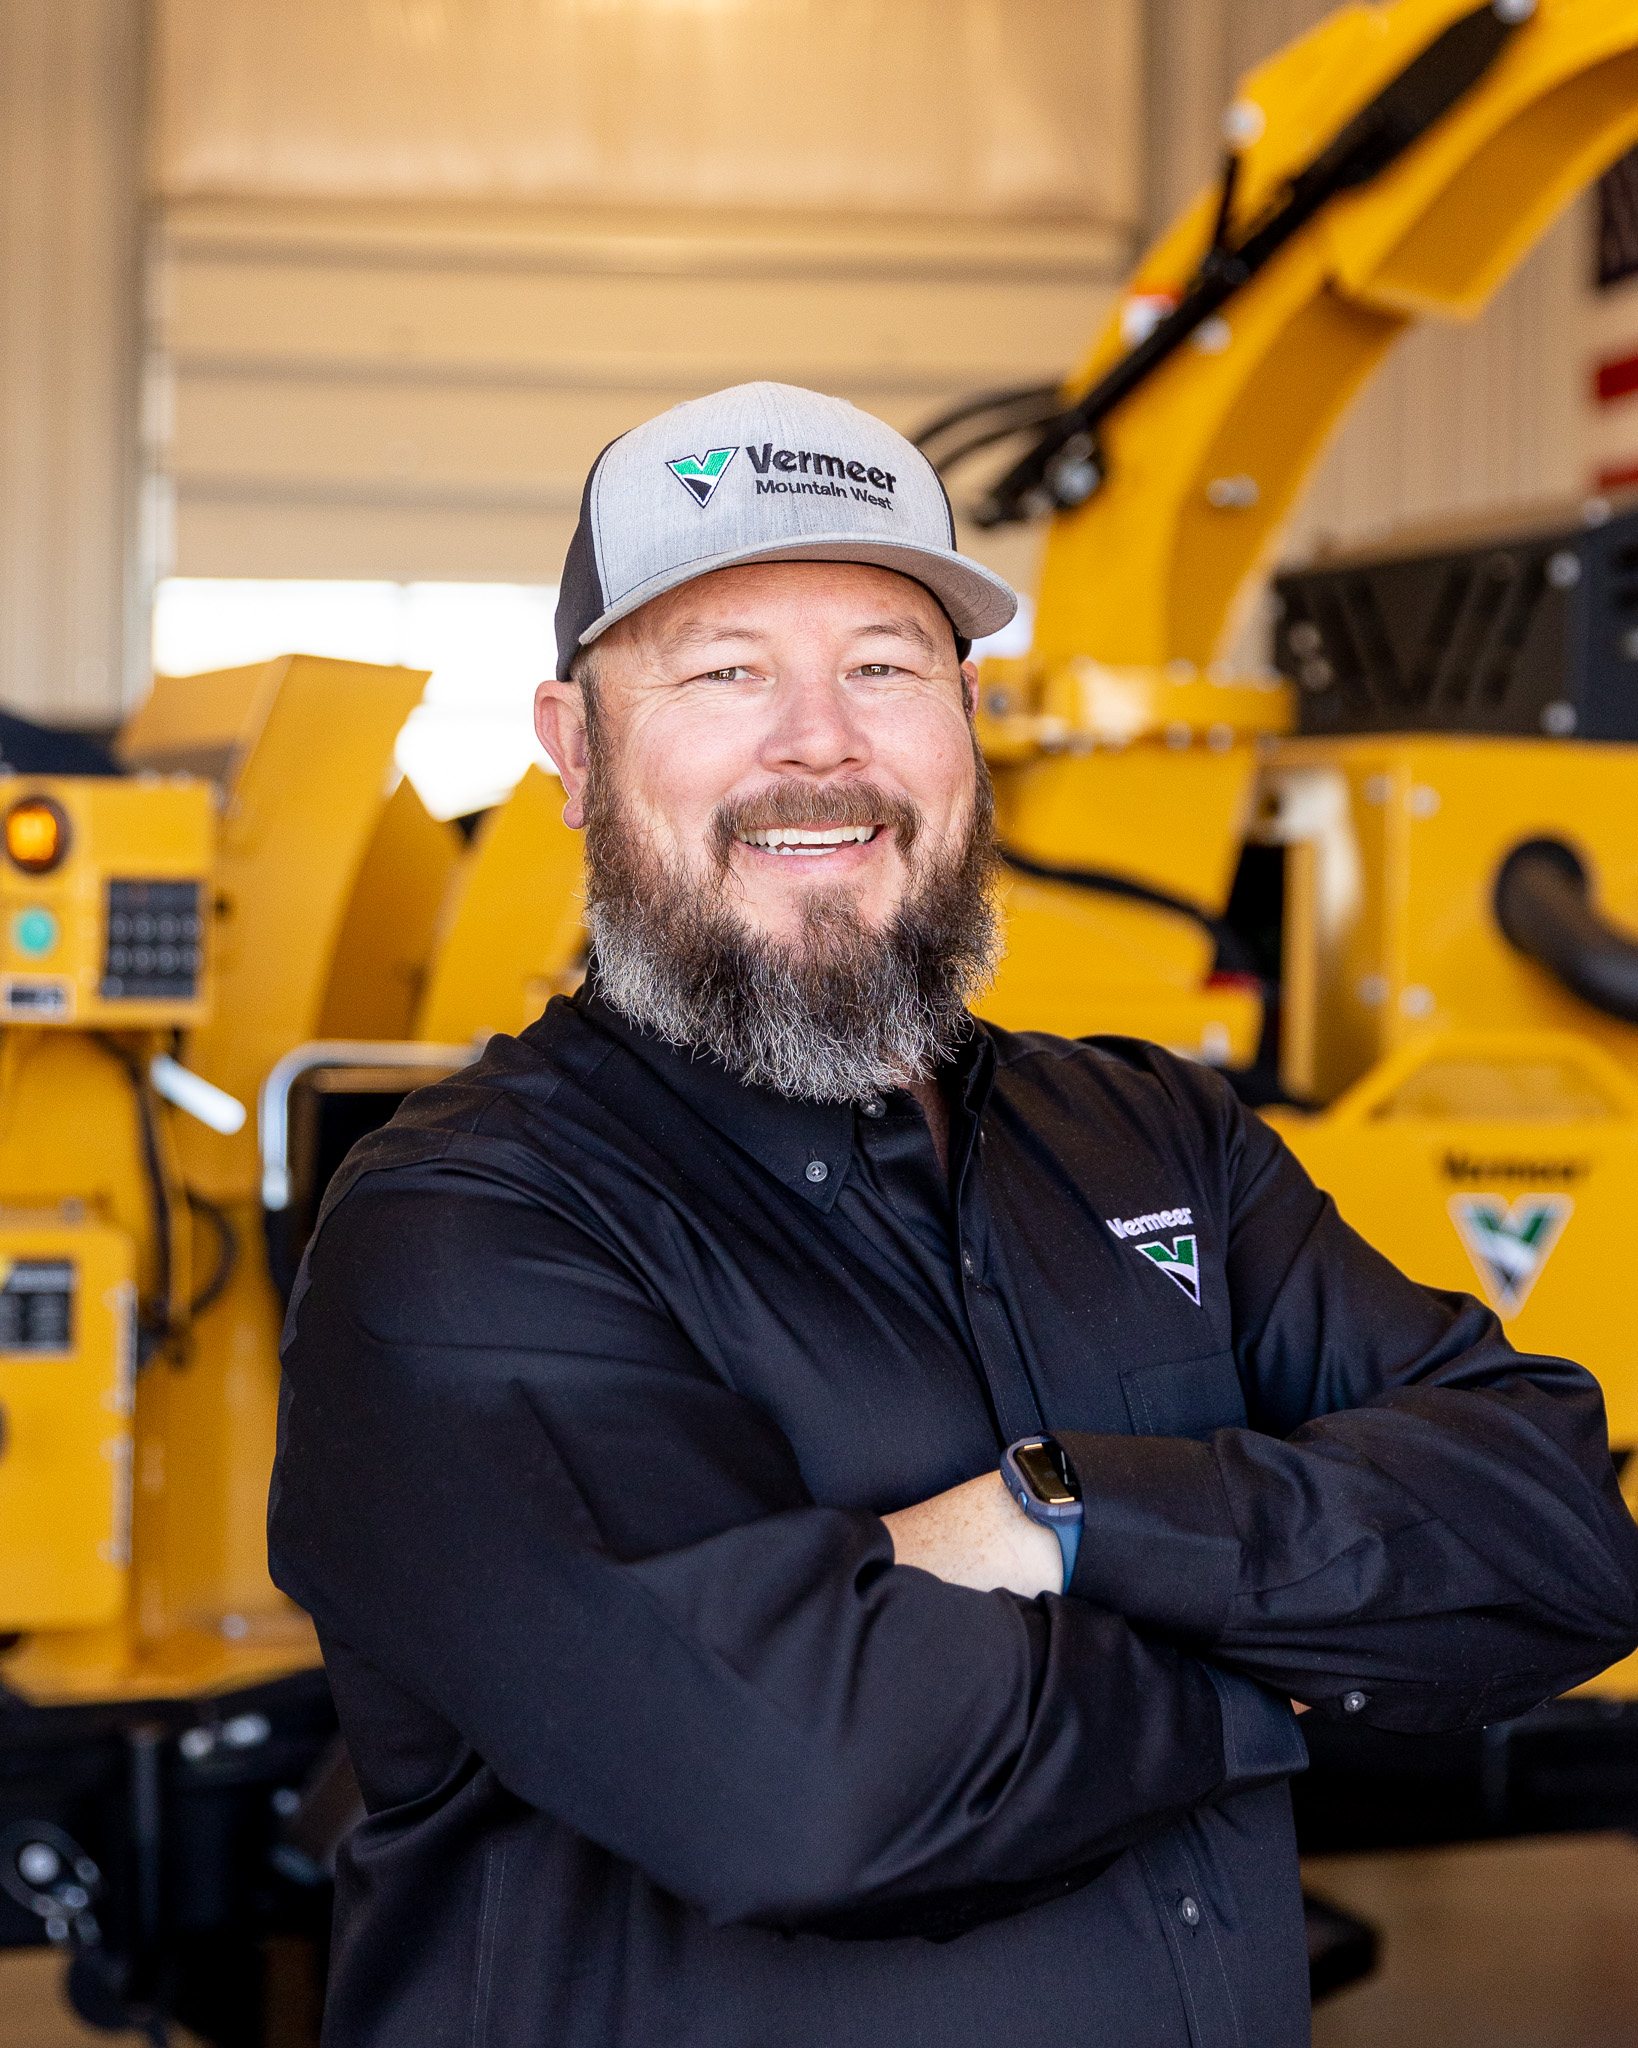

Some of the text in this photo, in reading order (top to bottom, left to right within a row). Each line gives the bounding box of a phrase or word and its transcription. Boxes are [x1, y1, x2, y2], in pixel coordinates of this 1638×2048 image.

[746, 443, 897, 493] Vermeer
[756, 480, 894, 512] Mountain West
[1106, 1208, 1193, 1239] Vermeer
